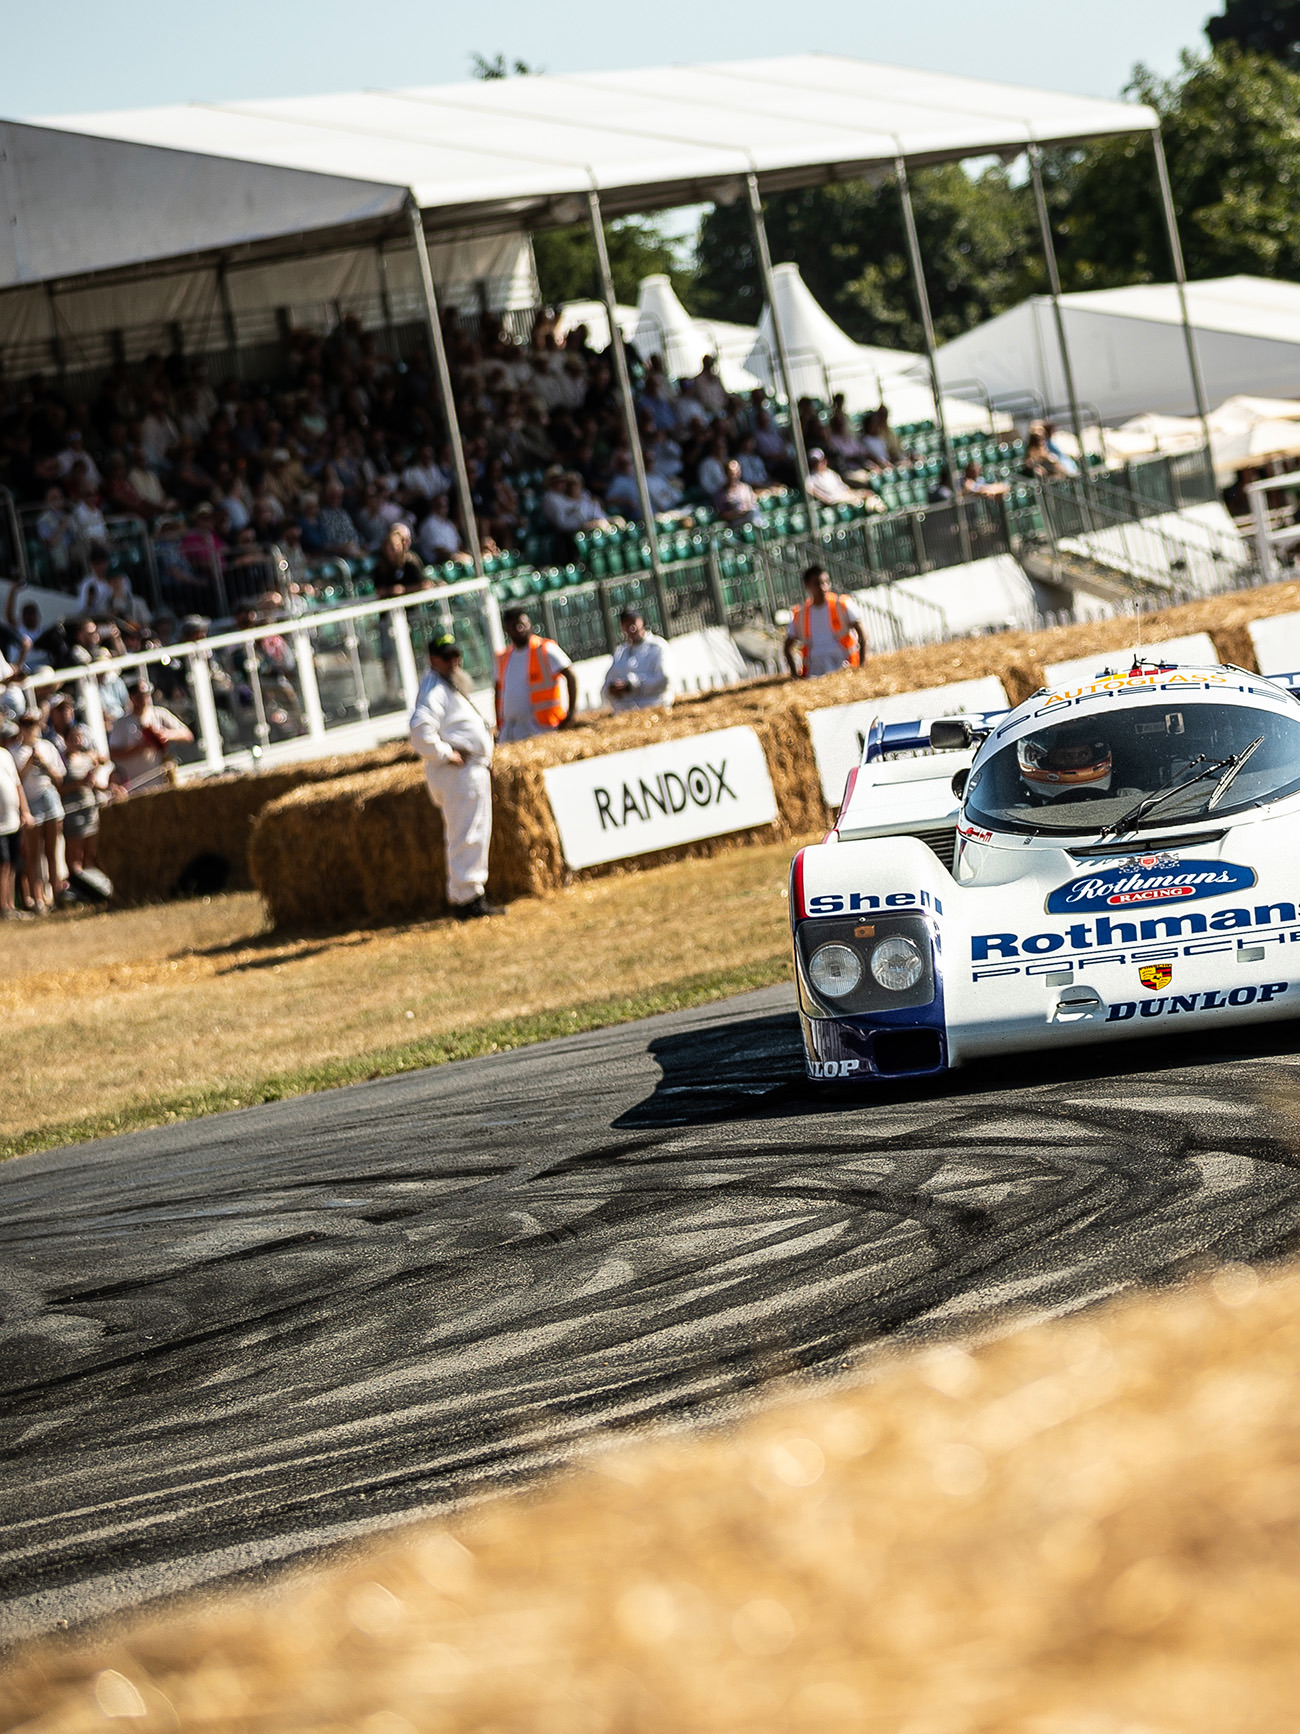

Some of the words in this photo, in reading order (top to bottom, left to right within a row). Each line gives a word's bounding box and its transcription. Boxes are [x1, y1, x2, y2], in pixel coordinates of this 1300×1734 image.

[1044, 674, 1227, 706] AUTOGLASS
[997, 682, 1287, 739] PORSCHE
[594, 759, 737, 829] RANDOX
[1066, 868, 1237, 903] Rothmans
[1119, 887, 1183, 902] RACING
[1105, 982, 1288, 1022] DUNLOP
